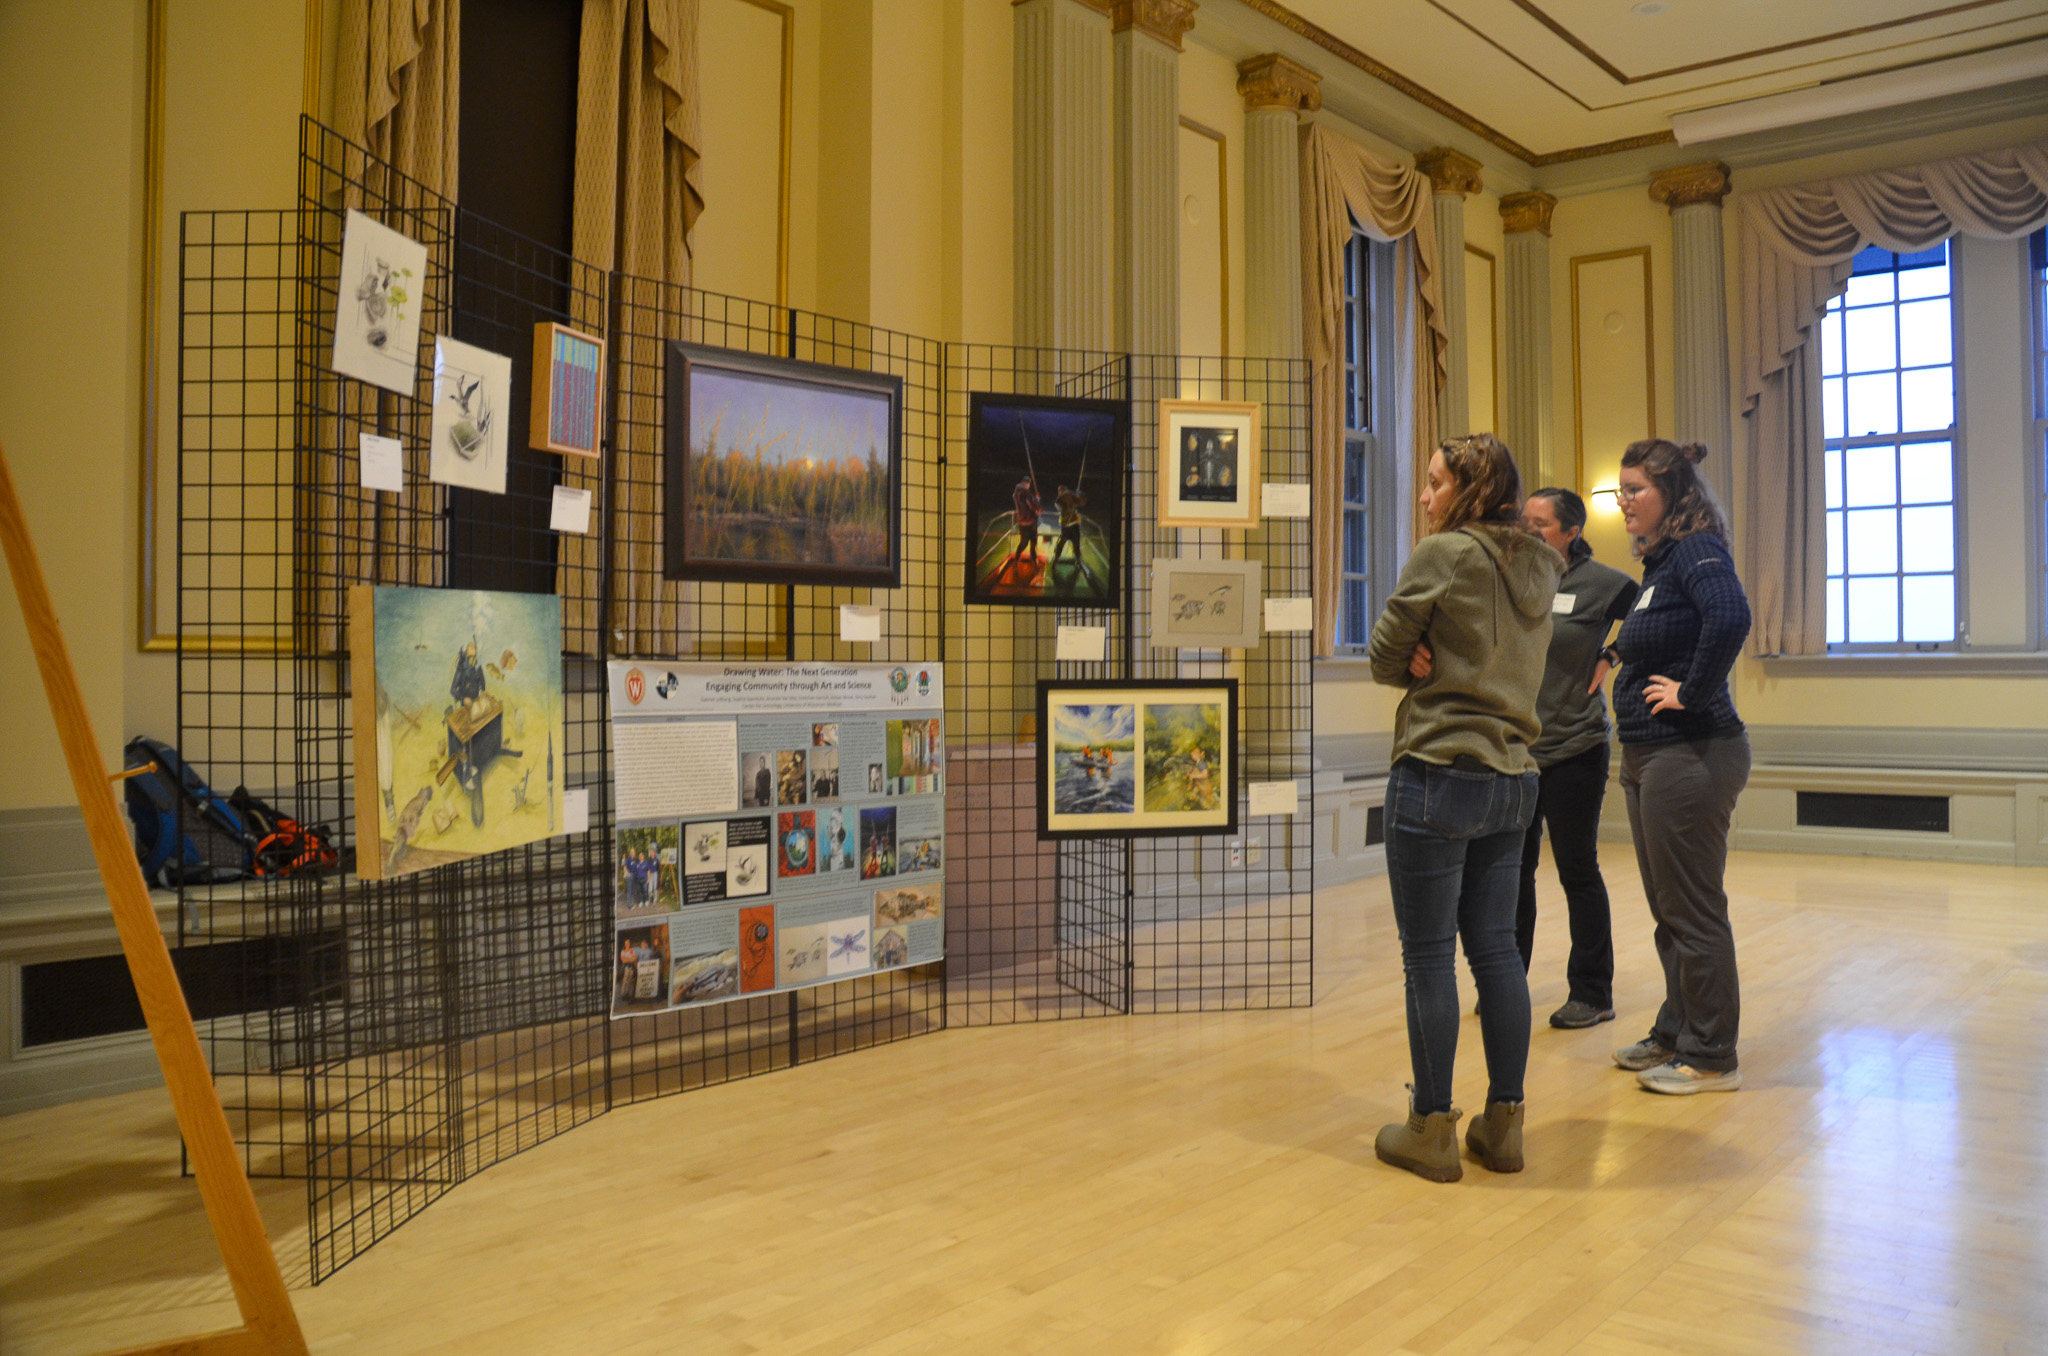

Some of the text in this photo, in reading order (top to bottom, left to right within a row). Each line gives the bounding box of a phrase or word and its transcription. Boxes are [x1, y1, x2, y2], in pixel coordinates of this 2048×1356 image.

[723, 667, 858, 678] Drawing Water: The Next Generation
[705, 681, 872, 692] Engaging Community through Art and Science
